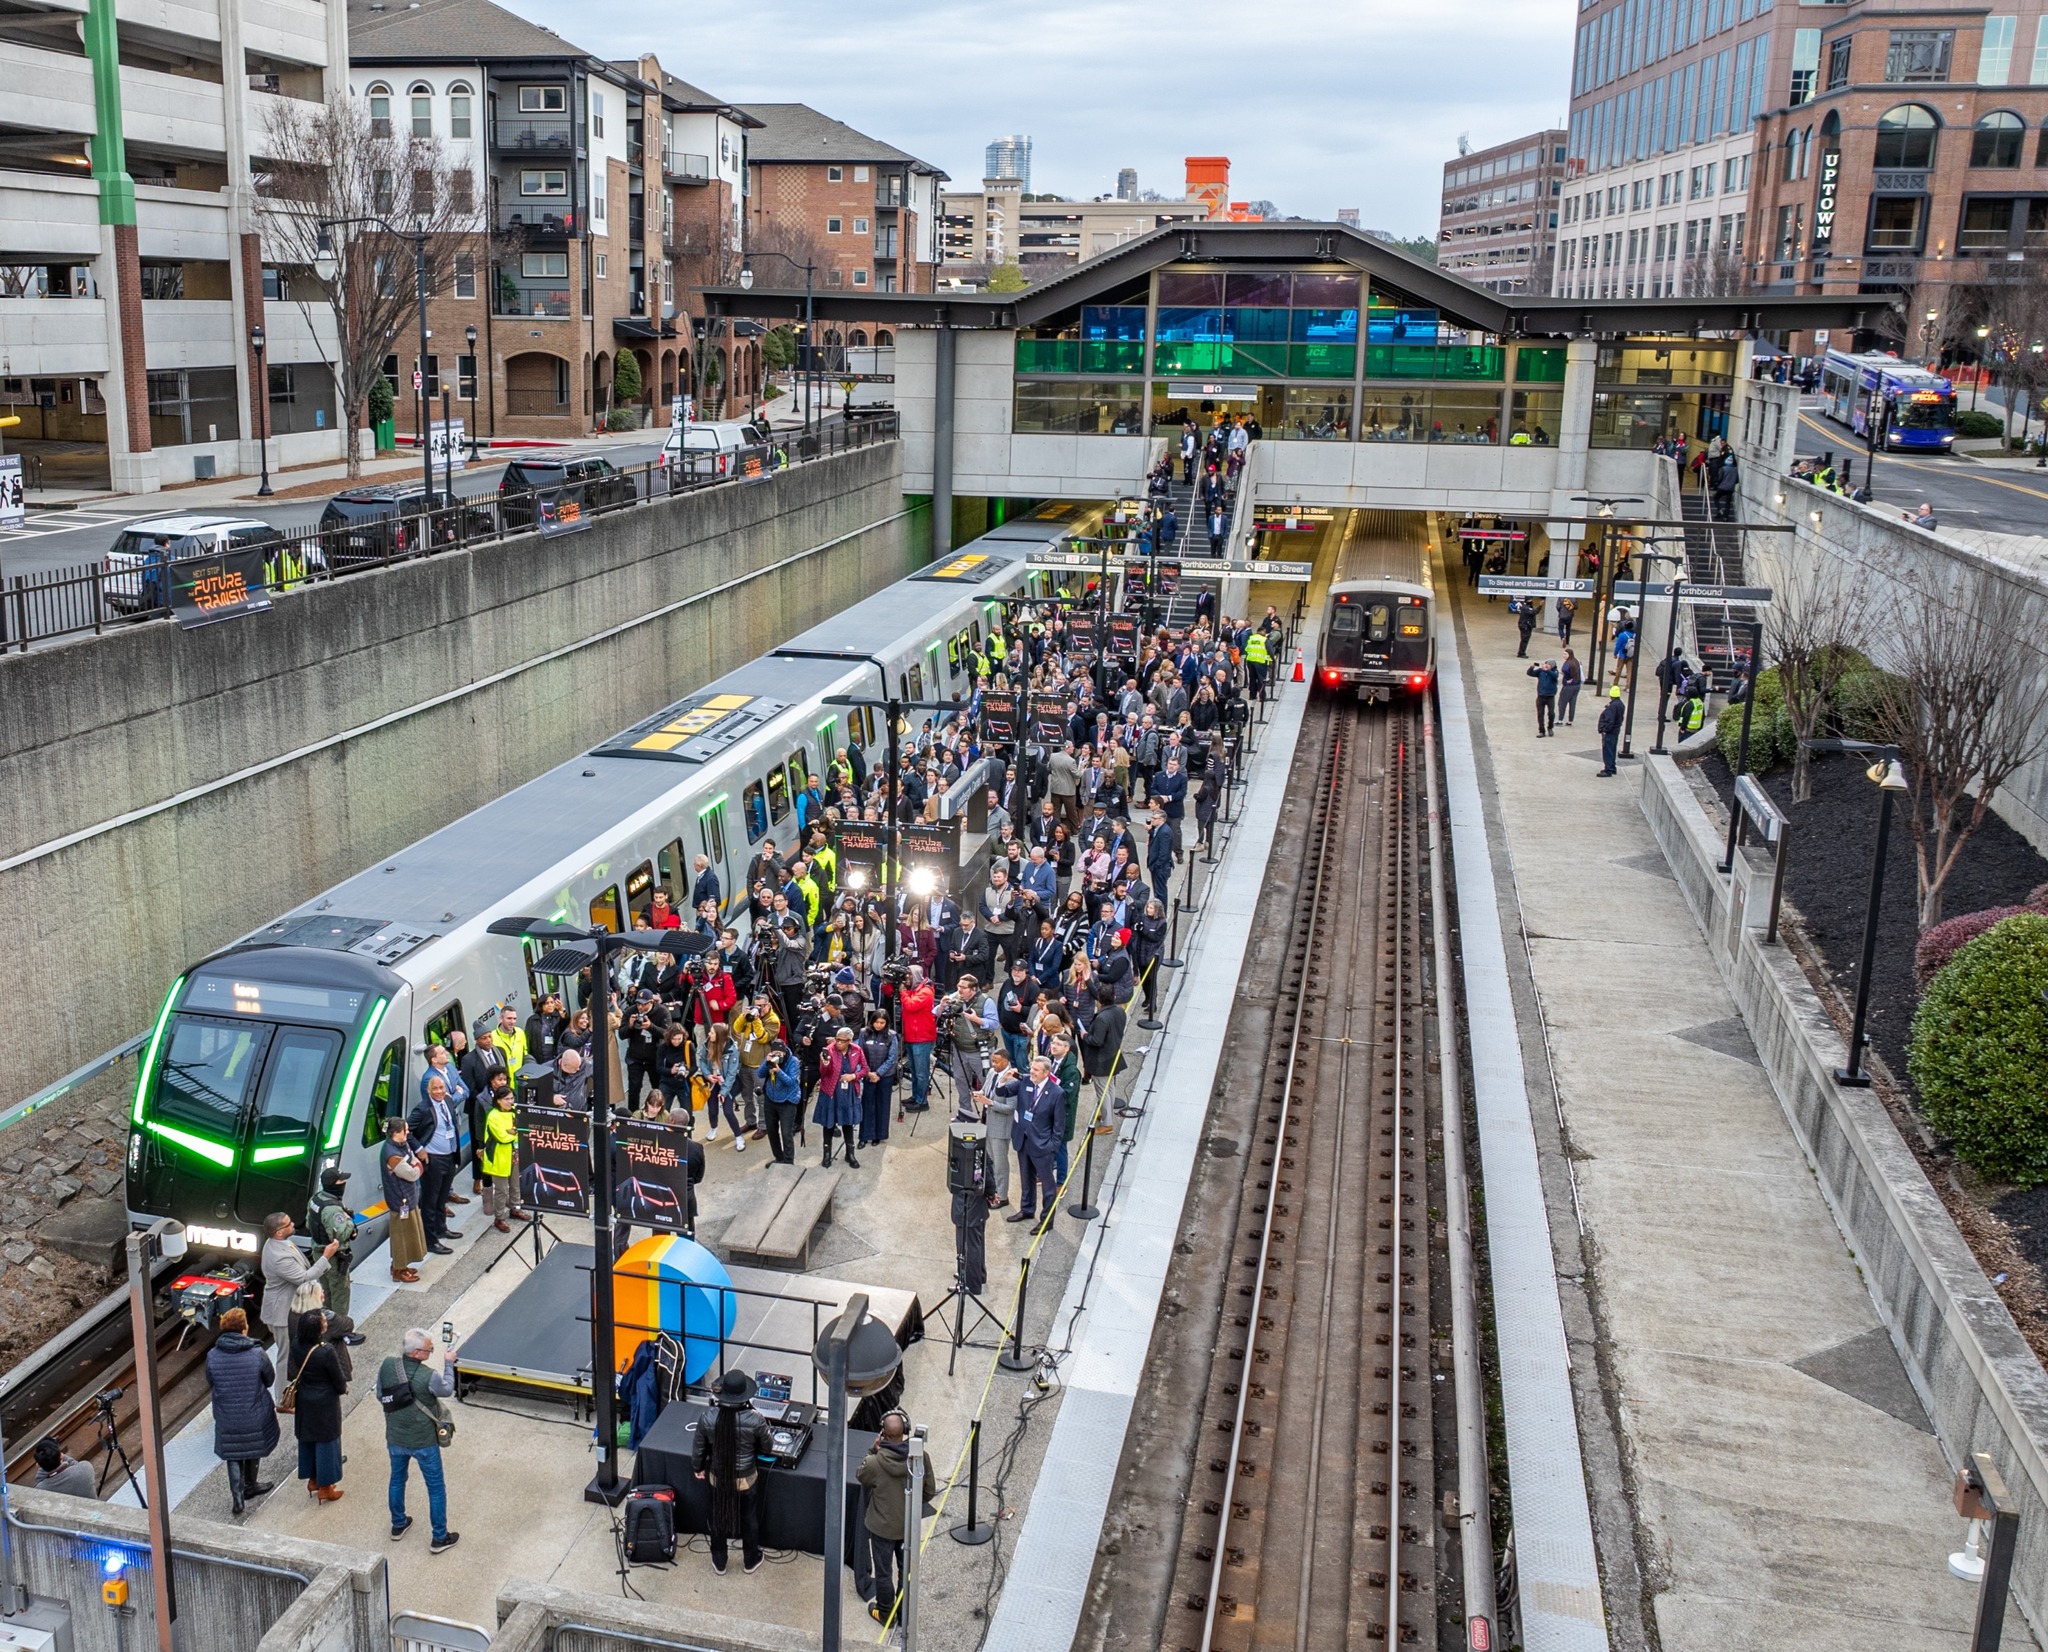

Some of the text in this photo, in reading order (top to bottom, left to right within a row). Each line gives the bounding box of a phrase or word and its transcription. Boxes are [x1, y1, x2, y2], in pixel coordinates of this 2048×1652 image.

[1816, 154, 1839, 239] UPTOWN
[1911, 393, 1941, 402] SPECIAL
[7, 458, 18, 466] RIDE
[1474, 511, 1498, 519] Elevator
[1033, 554, 1042, 562] To
[1044, 554, 1065, 563] Street
[1181, 561, 1222, 569] Northbound
[1270, 564, 1279, 572] To
[1281, 565, 1304, 573] Street
[194, 571, 242, 595] FUTURE
[1496, 579, 1514, 587] Street
[194, 587, 249, 610] TRANSIT
[1404, 626, 1420, 635] 306
[842, 835, 875, 843] FUTURE
[909, 839, 942, 847] FUTURE
[842, 841, 877, 849] TRANSIT
[909, 844, 944, 853] TRANSIT
[646, 1123, 664, 1131] marta
[529, 1130, 576, 1143] FUTURE
[529, 1137, 580, 1152] TRANSIT
[627, 1142, 675, 1158] FUTURE
[627, 1151, 679, 1168] TRANSIT
[557, 1199, 575, 1208] marta
[655, 1214, 673, 1223] marta
[186, 1225, 257, 1253] marta
[1473, 1620, 1487, 1647] DANGER
